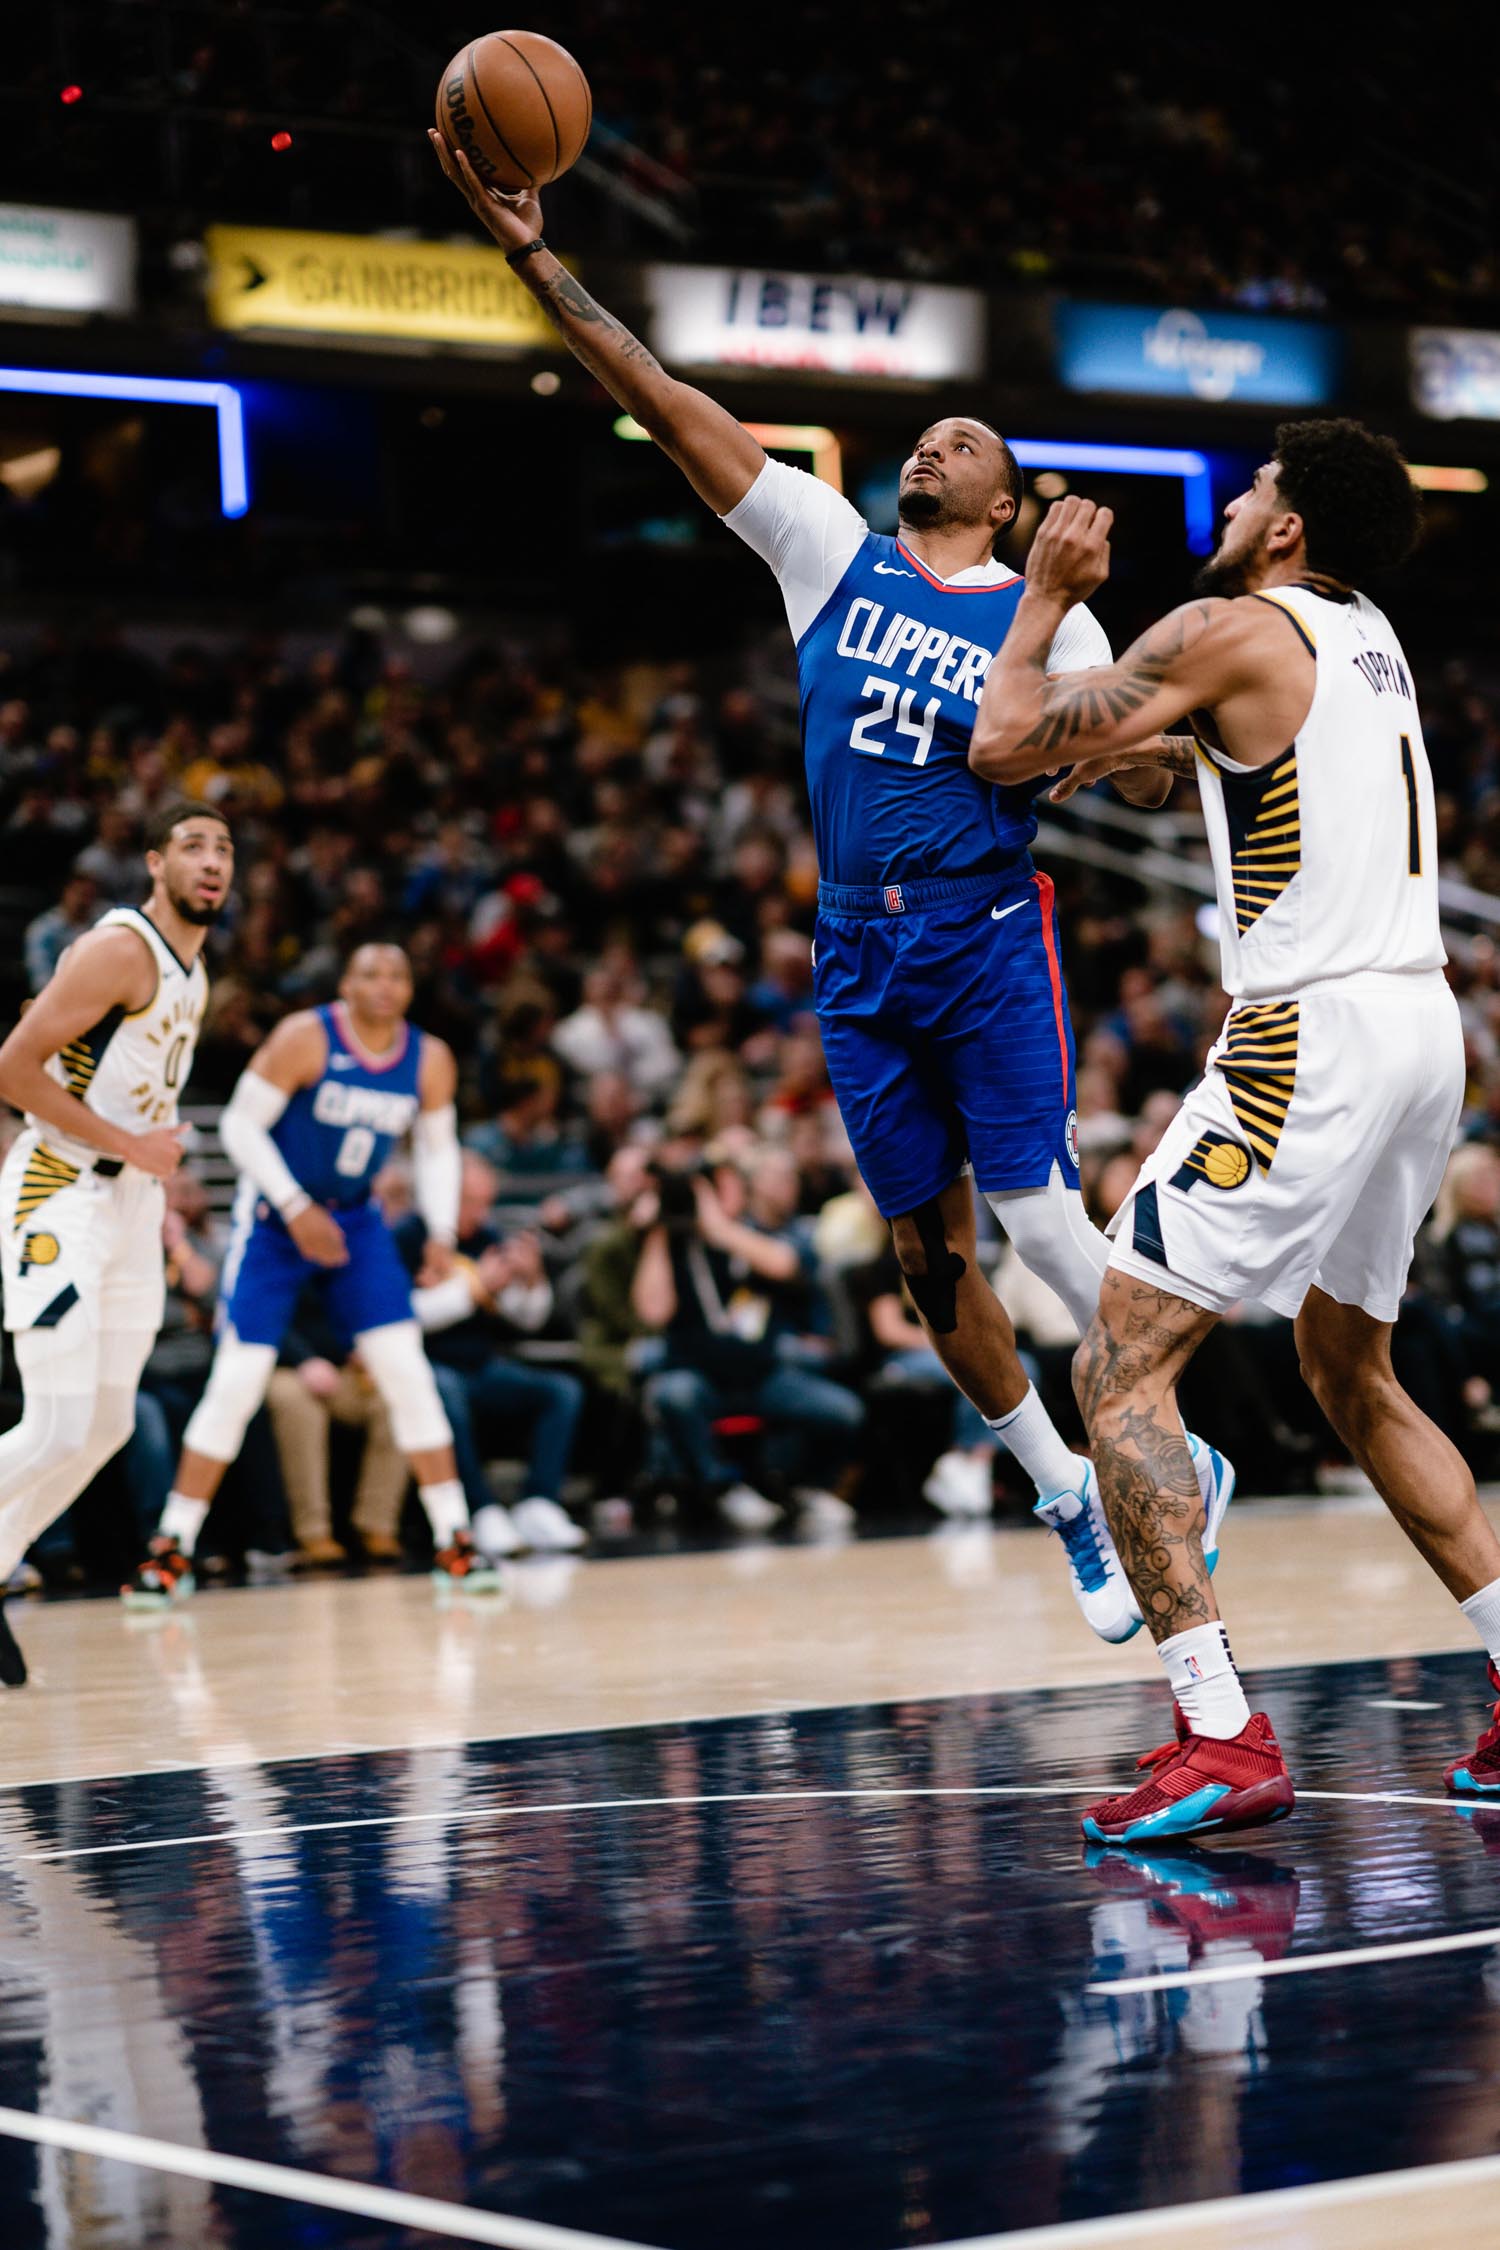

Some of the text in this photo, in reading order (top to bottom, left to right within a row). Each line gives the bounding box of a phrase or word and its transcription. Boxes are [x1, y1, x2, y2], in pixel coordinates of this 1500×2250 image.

[446, 73, 497, 174] Wilson
[725, 268, 914, 337] IBEW
[1352, 651, 1411, 701] TOPPIN
[850, 675, 942, 766] 24
[1399, 732, 1422, 878] 1
[164, 1033, 188, 1088] 0
[335, 1126, 376, 1178] 0
